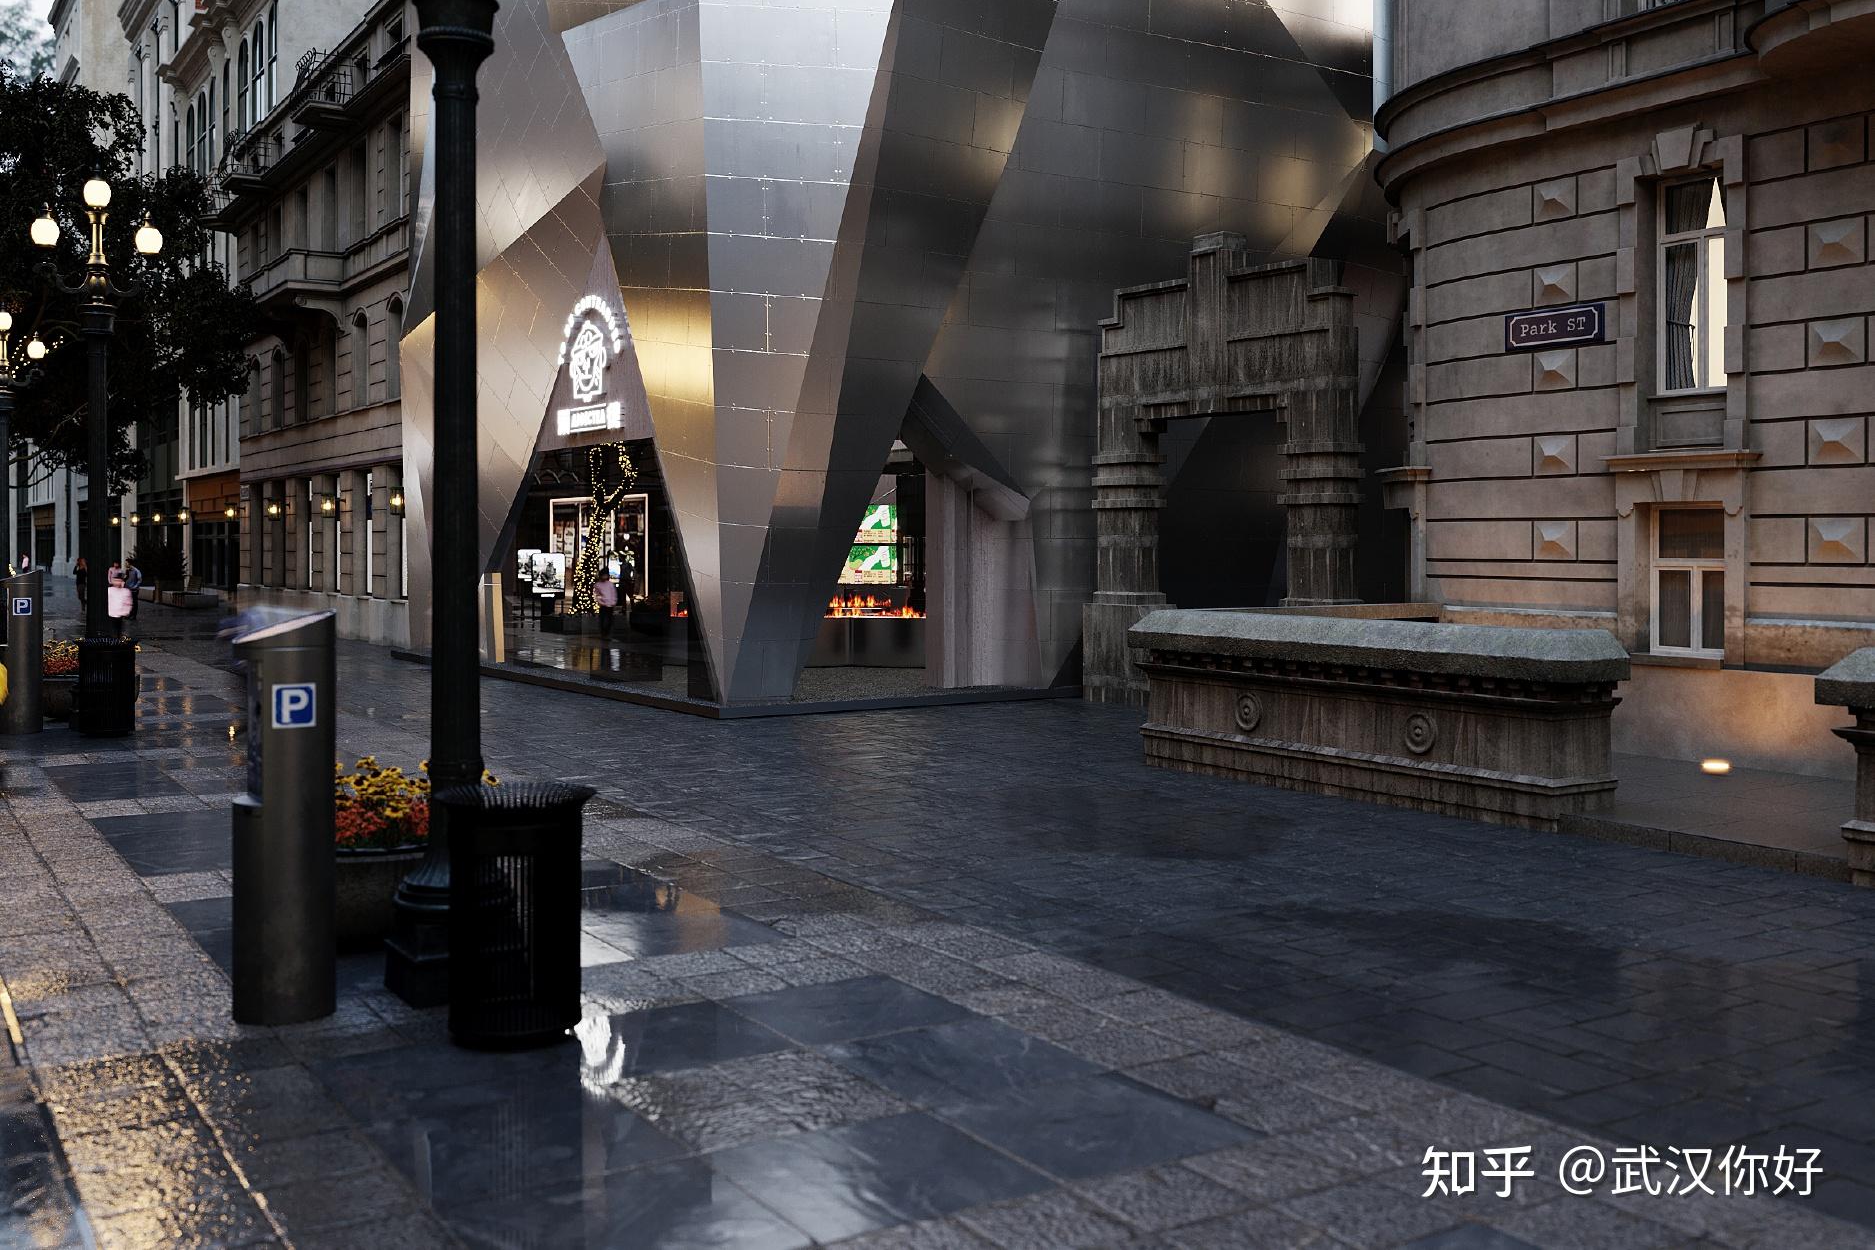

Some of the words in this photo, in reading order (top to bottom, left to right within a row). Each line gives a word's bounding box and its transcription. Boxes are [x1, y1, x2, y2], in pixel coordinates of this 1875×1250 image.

[1520, 320, 1557, 337] Park
[1567, 316, 1586, 331] ST
[16, 599, 29, 614] P
[281, 689, 310, 724] P
